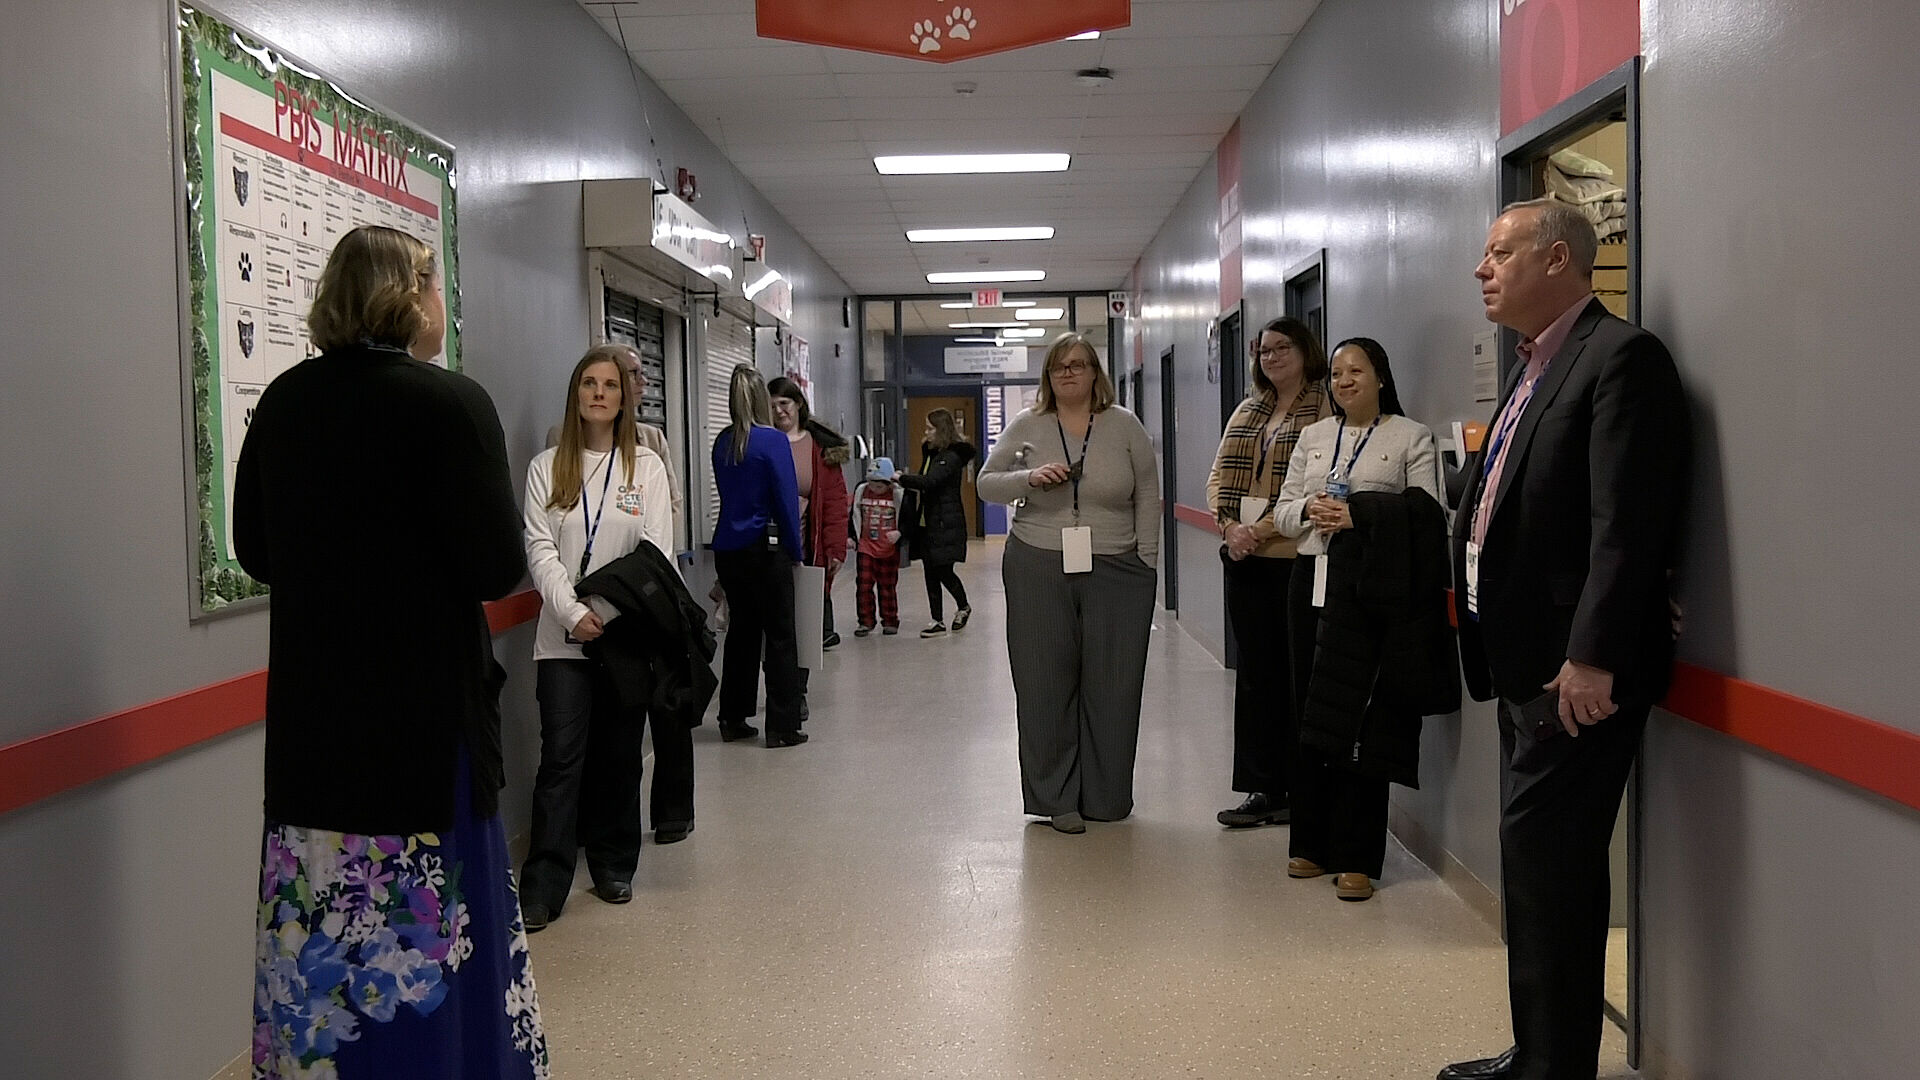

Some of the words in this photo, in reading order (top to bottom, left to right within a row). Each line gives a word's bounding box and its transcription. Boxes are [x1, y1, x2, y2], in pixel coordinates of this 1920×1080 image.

[274, 80, 322, 155] PBIS
[333, 110, 409, 194] MATRIX
[977, 288, 999, 306] EXIT
[986, 386, 1002, 441] ULINARY
